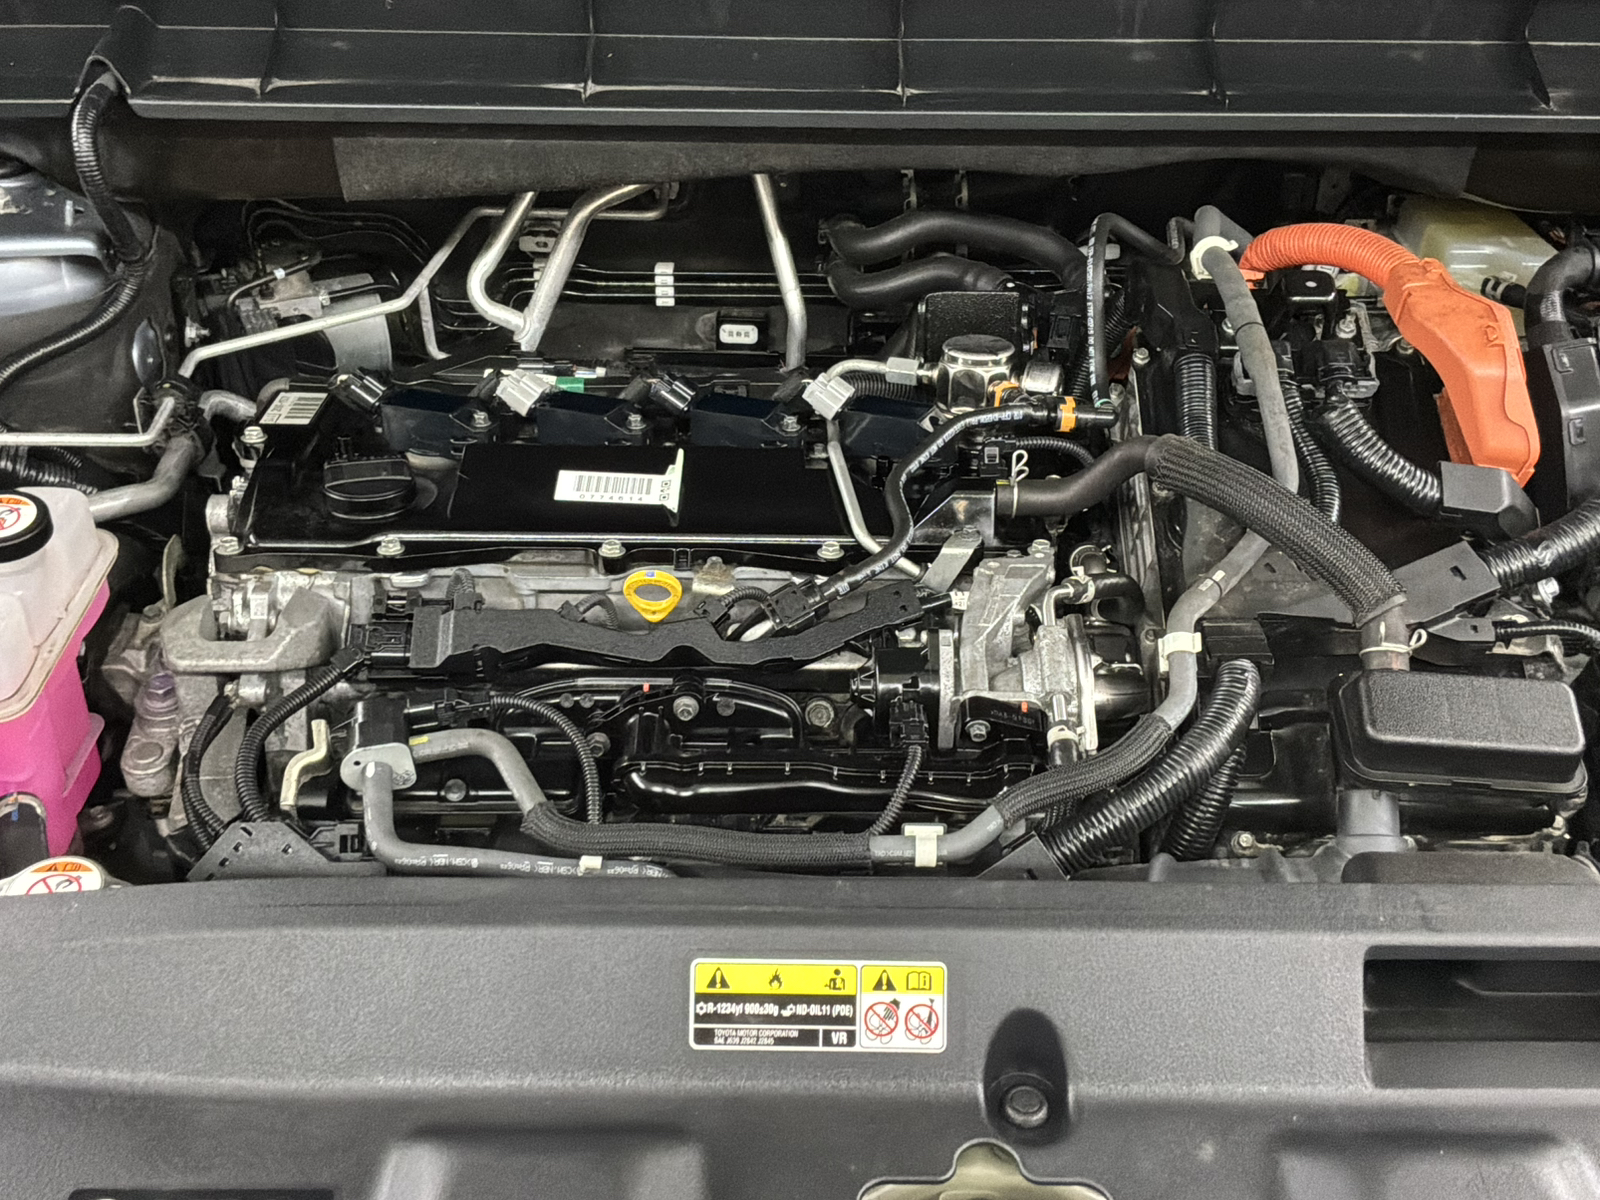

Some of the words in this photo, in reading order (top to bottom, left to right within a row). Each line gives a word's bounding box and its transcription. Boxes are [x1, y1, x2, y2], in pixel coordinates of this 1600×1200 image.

[579, 493, 643, 502] 0774614
[796, 1003, 831, 1017] ND-OIL11
[832, 1004, 854, 1018] (POE)
[714, 1028, 737, 1037] TOYOTA
[737, 1029, 758, 1037] MOTOR
[758, 1029, 799, 1038] CORPORATION
[831, 1031, 848, 1045] VR
[714, 1036, 725, 1044] SAE
